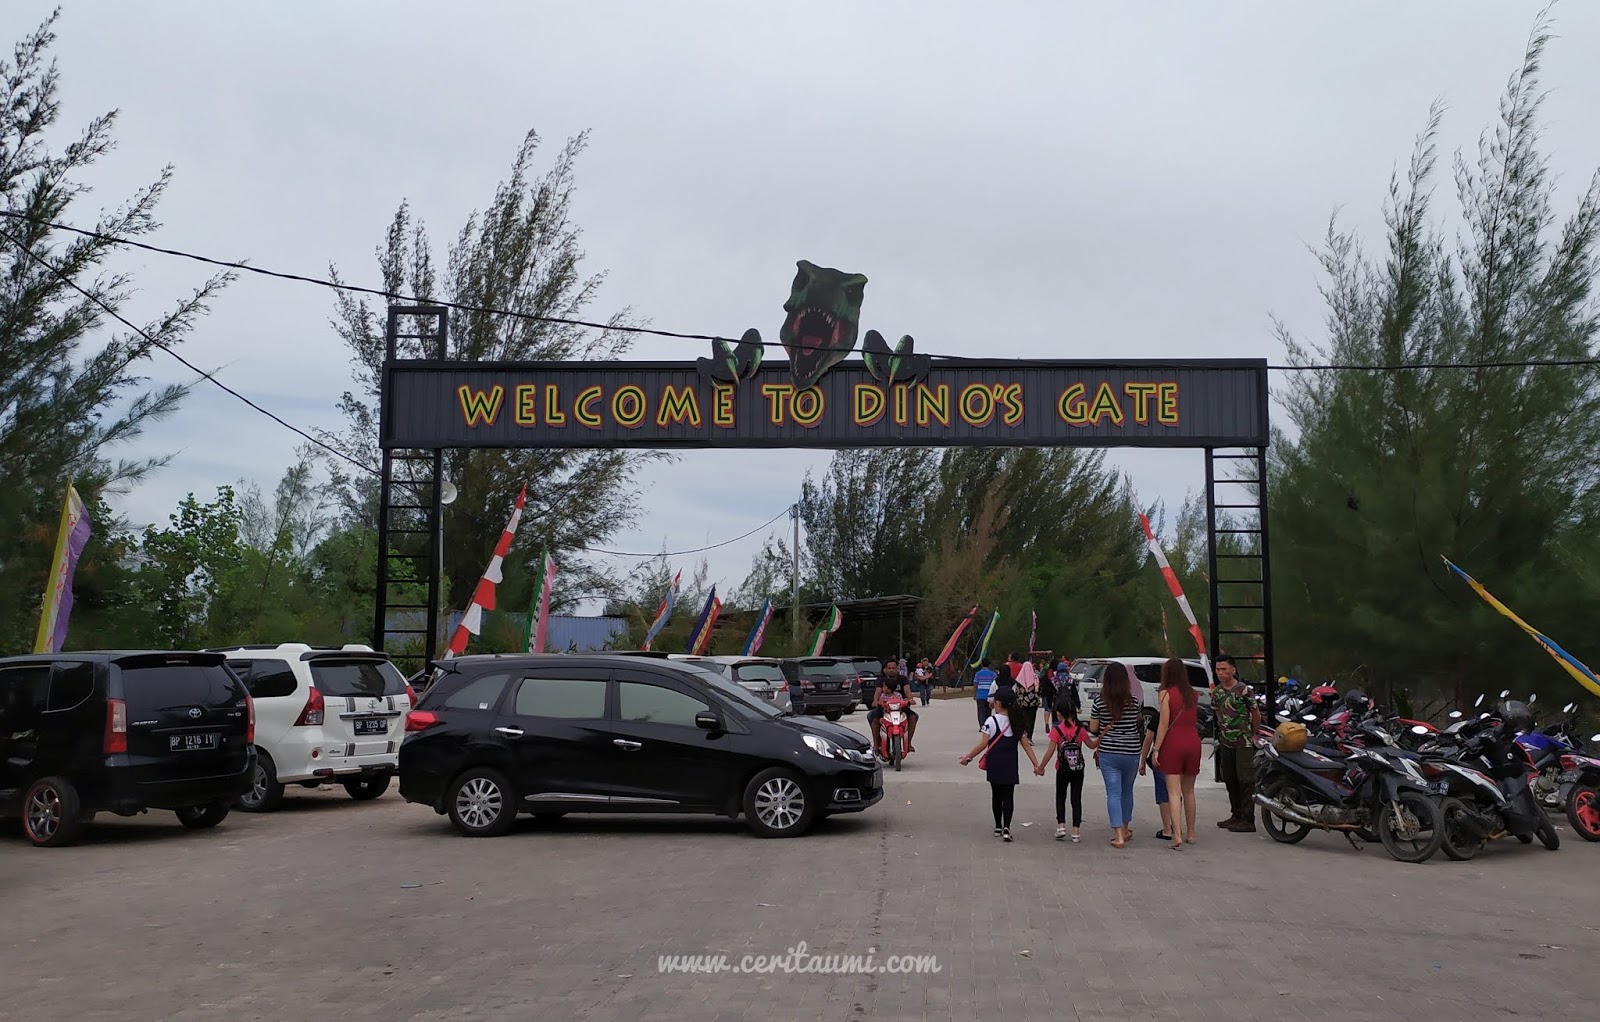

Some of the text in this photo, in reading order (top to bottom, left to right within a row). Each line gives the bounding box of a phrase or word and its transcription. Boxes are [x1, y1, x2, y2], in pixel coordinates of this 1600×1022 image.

[457, 382, 1180, 429] WELCOME TO DINO'S GATE
[171, 736, 180, 746] BP
[185, 735, 202, 745] 1216
